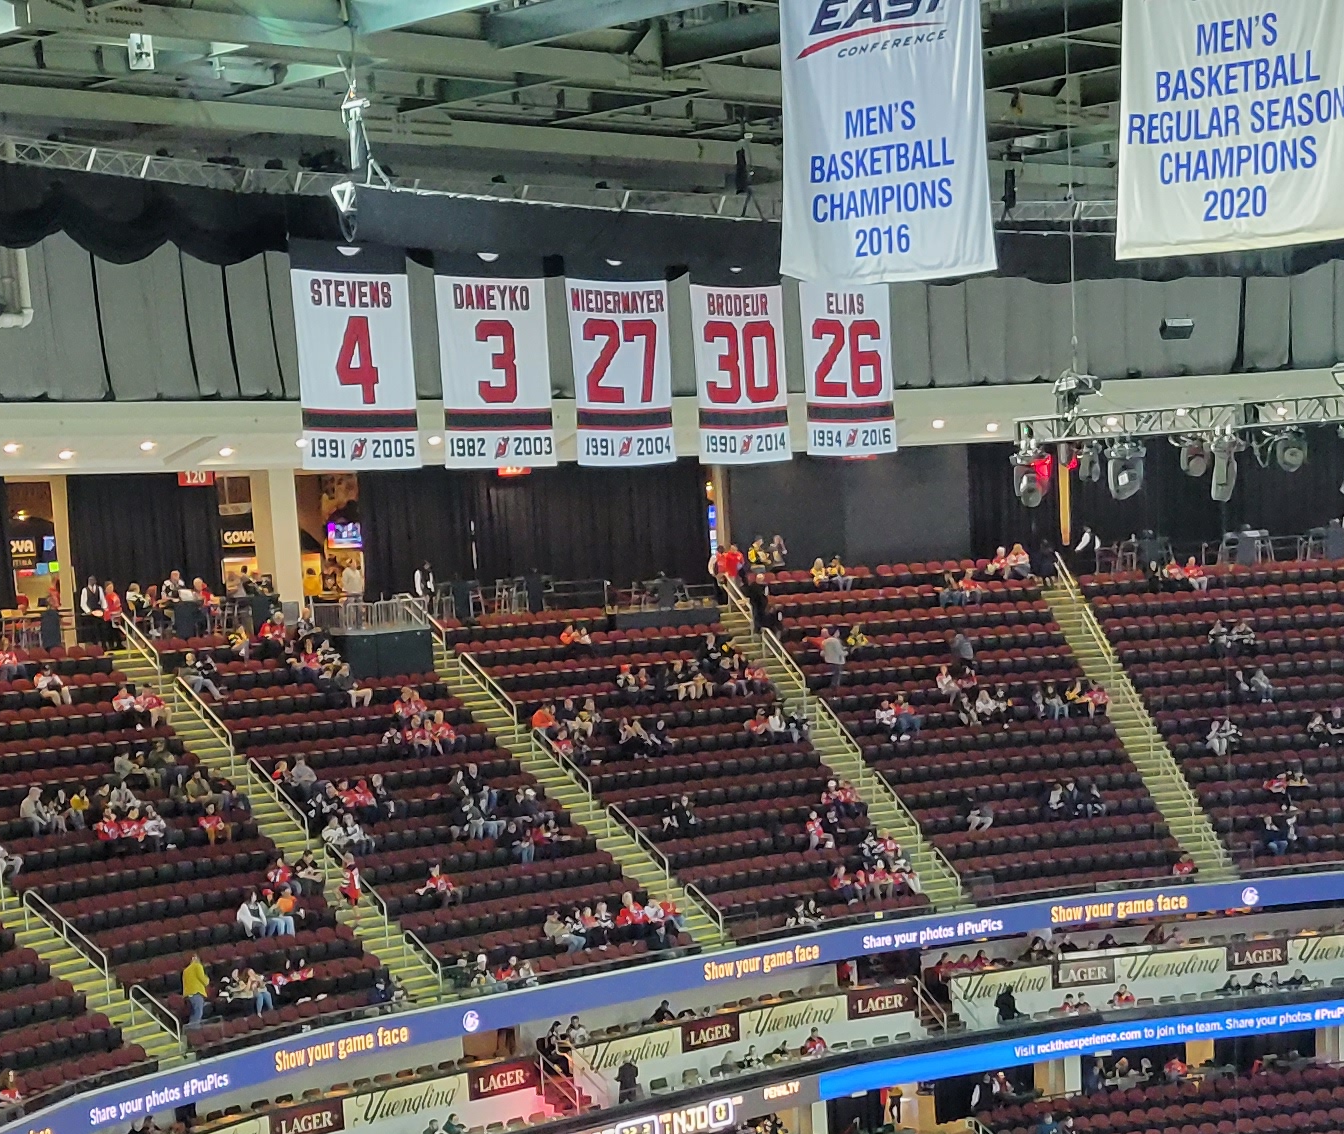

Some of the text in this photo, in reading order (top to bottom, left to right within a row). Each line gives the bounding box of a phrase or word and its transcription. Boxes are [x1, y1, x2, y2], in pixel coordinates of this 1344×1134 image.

[838, 30, 947, 58] CONFERENCE
[1196, 12, 1278, 56] MEN'S
[1156, 50, 1321, 102] BASKETBALL
[844, 100, 916, 139] MEN'S
[1128, 108, 1240, 146] REGULAR
[810, 137, 955, 184] BASKETBALL
[1160, 136, 1318, 185] CHAMPIONS
[812, 178, 952, 223] CHAMPIONS
[1204, 186, 1267, 222] 2020
[855, 224, 910, 258] 2016
[310, 278, 392, 309] STEVENS
[454, 283, 529, 312] DANEYKO
[571, 287, 665, 315] NIEDERMAYER
[707, 291, 769, 317] BRODEUR
[826, 292, 864, 315] ELIAS
[336, 315, 378, 404] 4
[476, 319, 516, 403] 3
[582, 319, 656, 403] 27
[703, 320, 778, 404] 30
[813, 319, 881, 397] 26
[310, 436, 415, 460] 1991 2005
[450, 435, 553, 458] 1982 2003
[585, 435, 672, 458] 1991 2004
[705, 430, 786, 454] 1990 2014
[813, 425, 891, 448] 1994 2016
[185, 471, 206, 484] 120
[1117, 948, 1281, 982] Yuengling LAGER
[275, 1025, 408, 1072] Show your game face
[90, 1072, 229, 1126] Share your photos #PruPics
[354, 1068, 525, 1127] Yuengling LAGER
[763, 1081, 800, 1100] PENALTY
